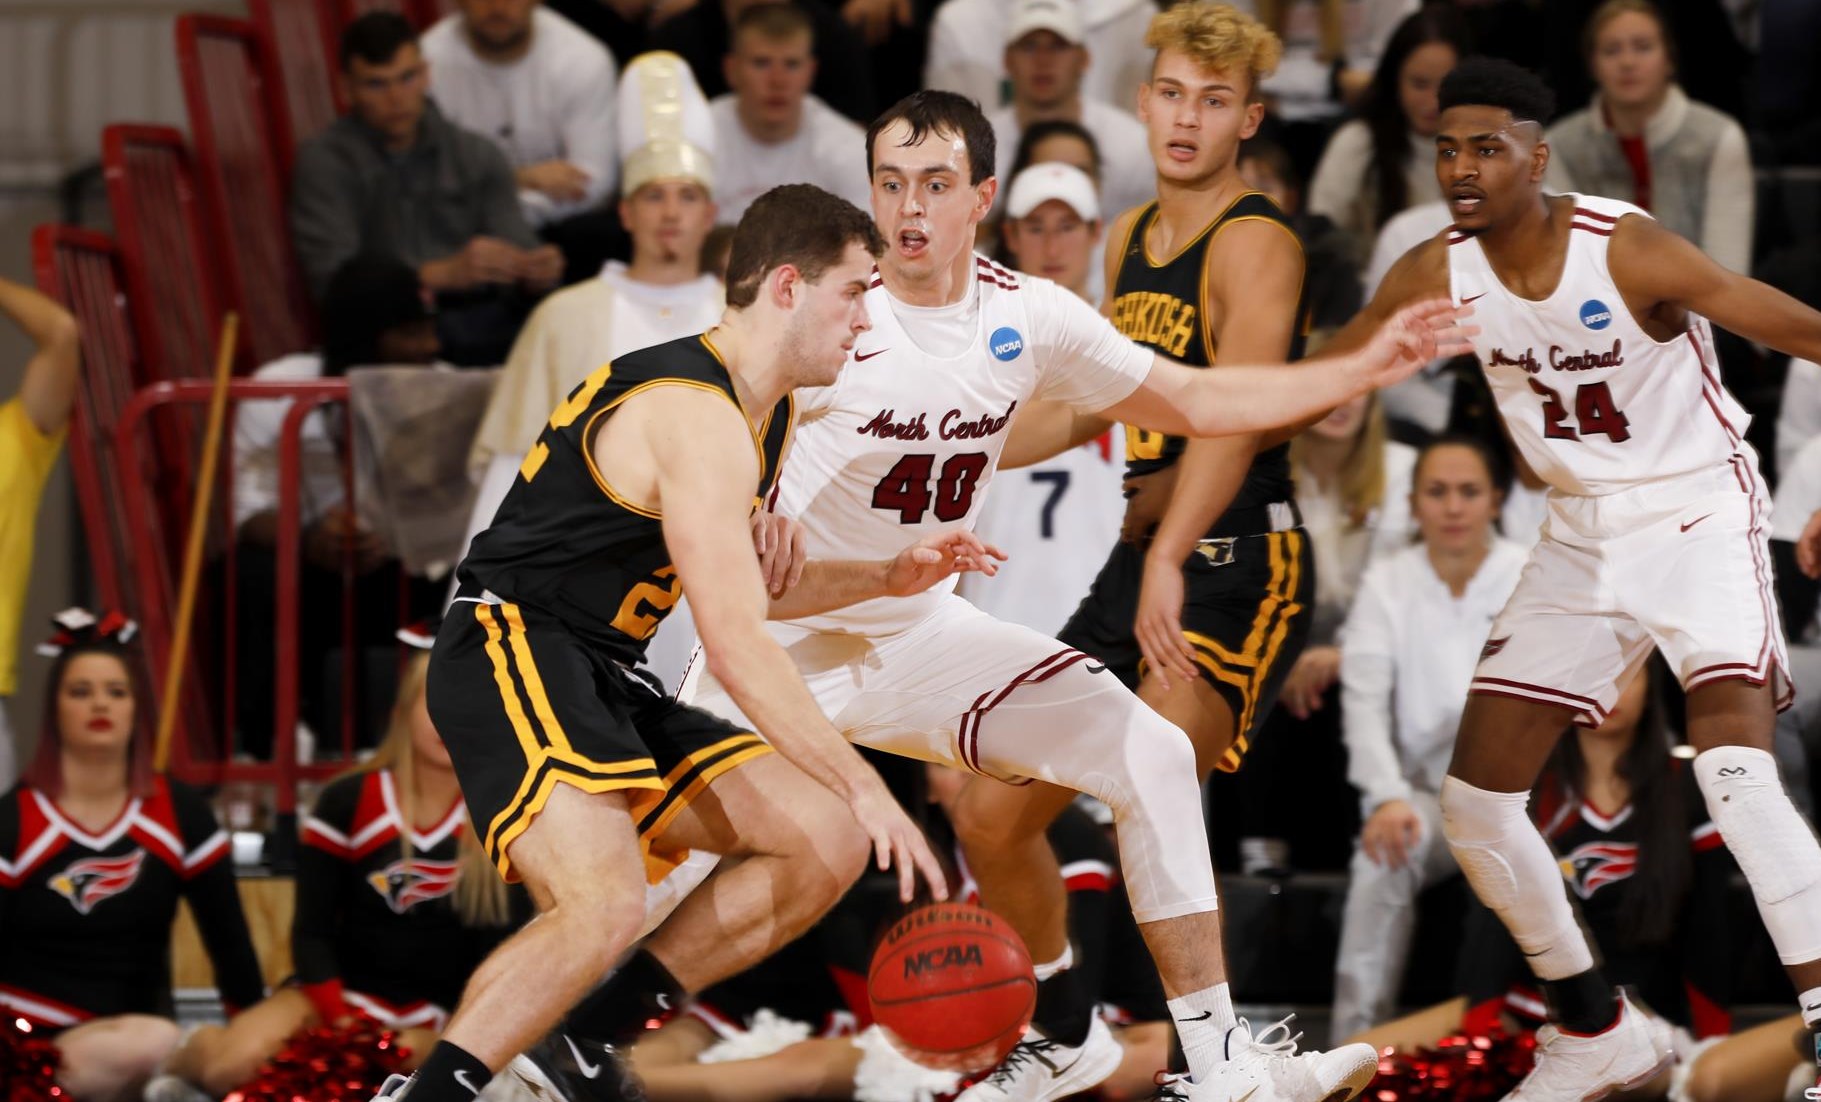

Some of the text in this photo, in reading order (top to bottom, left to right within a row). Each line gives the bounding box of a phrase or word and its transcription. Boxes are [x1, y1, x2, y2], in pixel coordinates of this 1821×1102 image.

[995, 339, 1022, 355] NCAA
[1113, 291, 1195, 358] SHKOSH
[1549, 338, 1624, 372] Central
[857, 400, 1018, 441] North Central
[1528, 376, 1632, 443] 24
[871, 451, 989, 524] 40
[1029, 469, 1071, 540] 7
[904, 943, 983, 979] NCAA
